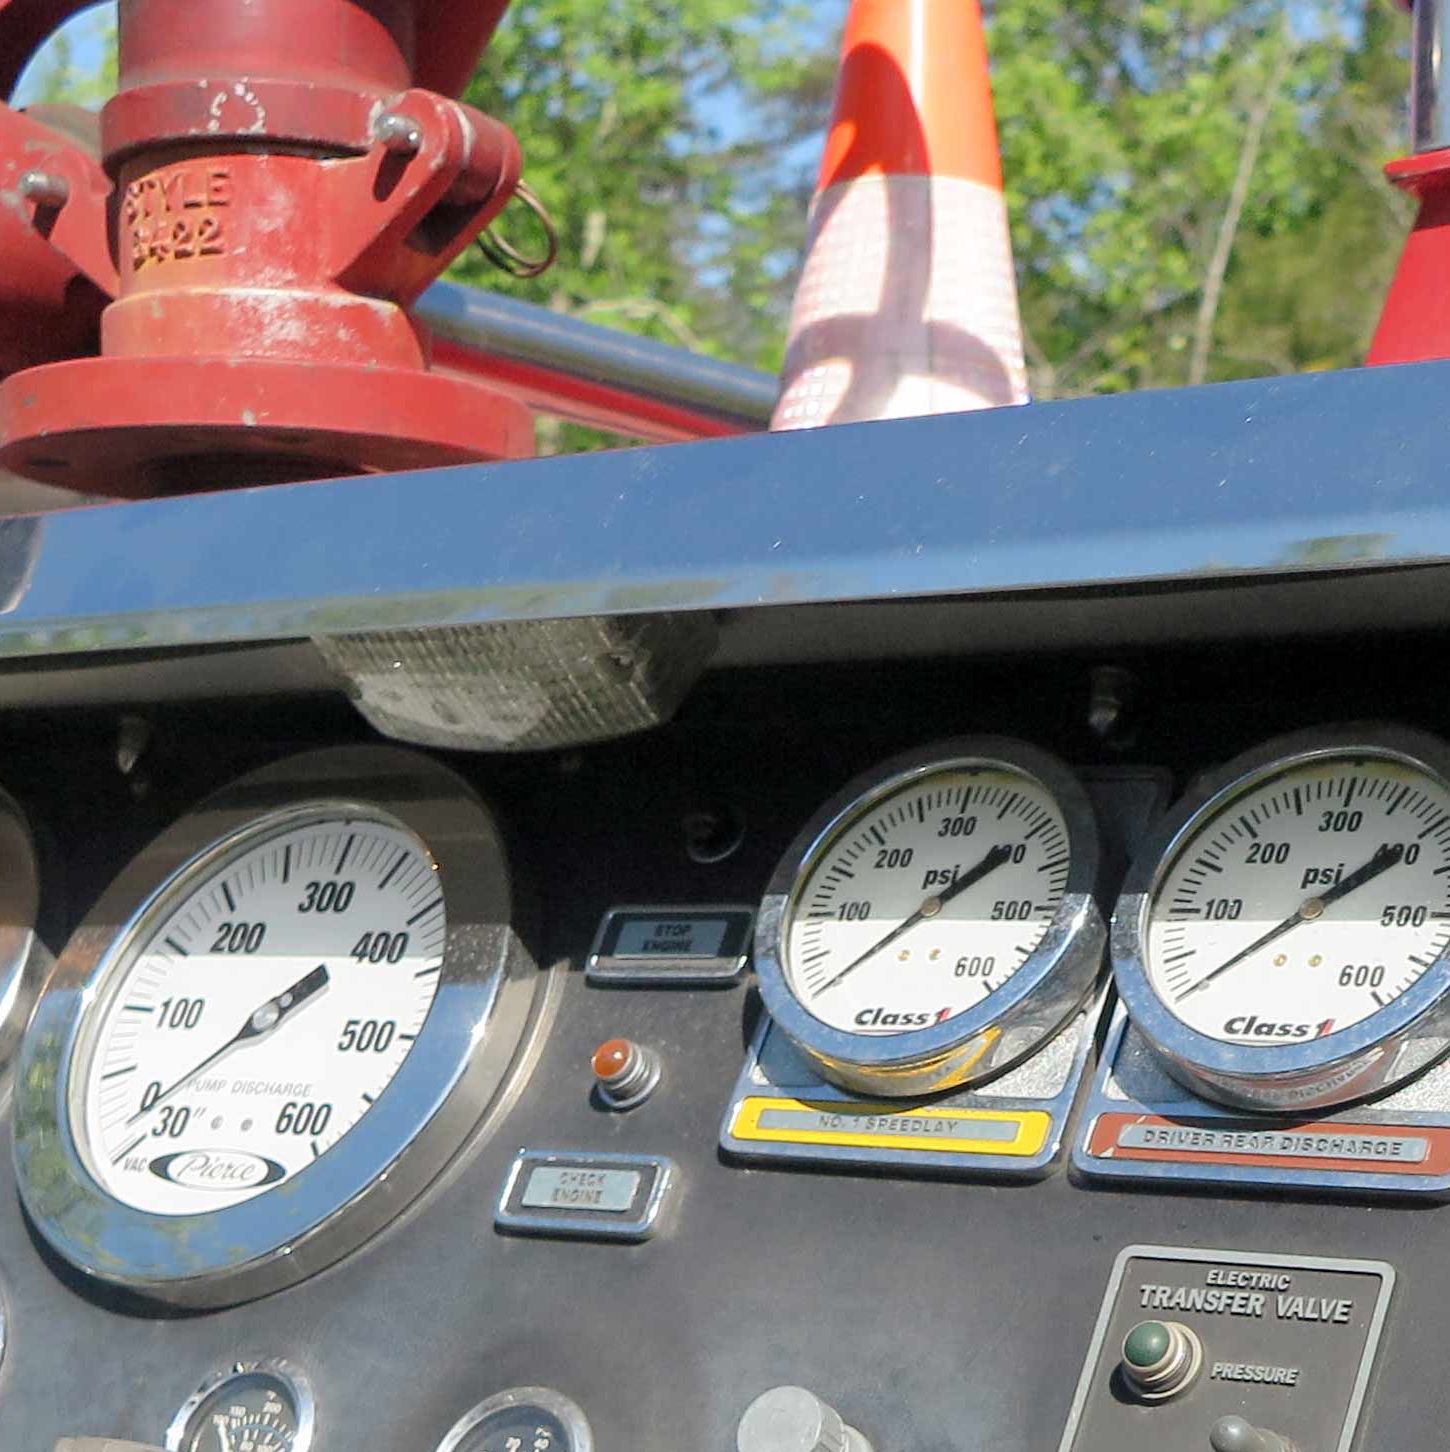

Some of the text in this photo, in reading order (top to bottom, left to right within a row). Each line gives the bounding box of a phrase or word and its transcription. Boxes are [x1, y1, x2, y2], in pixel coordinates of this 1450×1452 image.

[127, 171, 230, 226] STYLE
[938, 816, 977, 836] 300
[1318, 810, 1363, 832] 300
[874, 847, 914, 869] 200
[1245, 842, 1291, 864] 200
[922, 864, 961, 889] psi
[1301, 864, 1344, 889] psi
[298, 881, 356, 913] 300
[837, 901, 871, 921] 100
[990, 900, 1032, 921] 500
[1205, 899, 1243, 920] 100
[1380, 905, 1427, 927] 500
[210, 921, 267, 954] 200
[653, 923, 693, 938] STOP
[350, 931, 409, 964] 400
[642, 938, 694, 952] ENGINE
[954, 956, 996, 977] 600
[1338, 964, 1385, 987] 600
[157, 997, 205, 1030] 100
[337, 1019, 397, 1052] 500
[139, 1081, 163, 1112] 0
[186, 1077, 313, 1098] PUMP DISCHARGE
[274, 1102, 333, 1137] 600
[816, 1113, 847, 1132] NO.
[861, 1116, 960, 1136] SPEEDLAY
[1141, 1127, 1405, 1158] DRIVER REAR DISCHARGE
[122, 1156, 147, 1173] VAC
[177, 1154, 257, 1180] Pierce
[558, 1171, 607, 1187] CHECK
[551, 1188, 605, 1205] ENGINE
[1206, 1269, 1292, 1291] ELECTRIC
[1139, 1284, 1352, 1323] TRANSFER VALVE
[1210, 1361, 1300, 1386] PRESSURE
